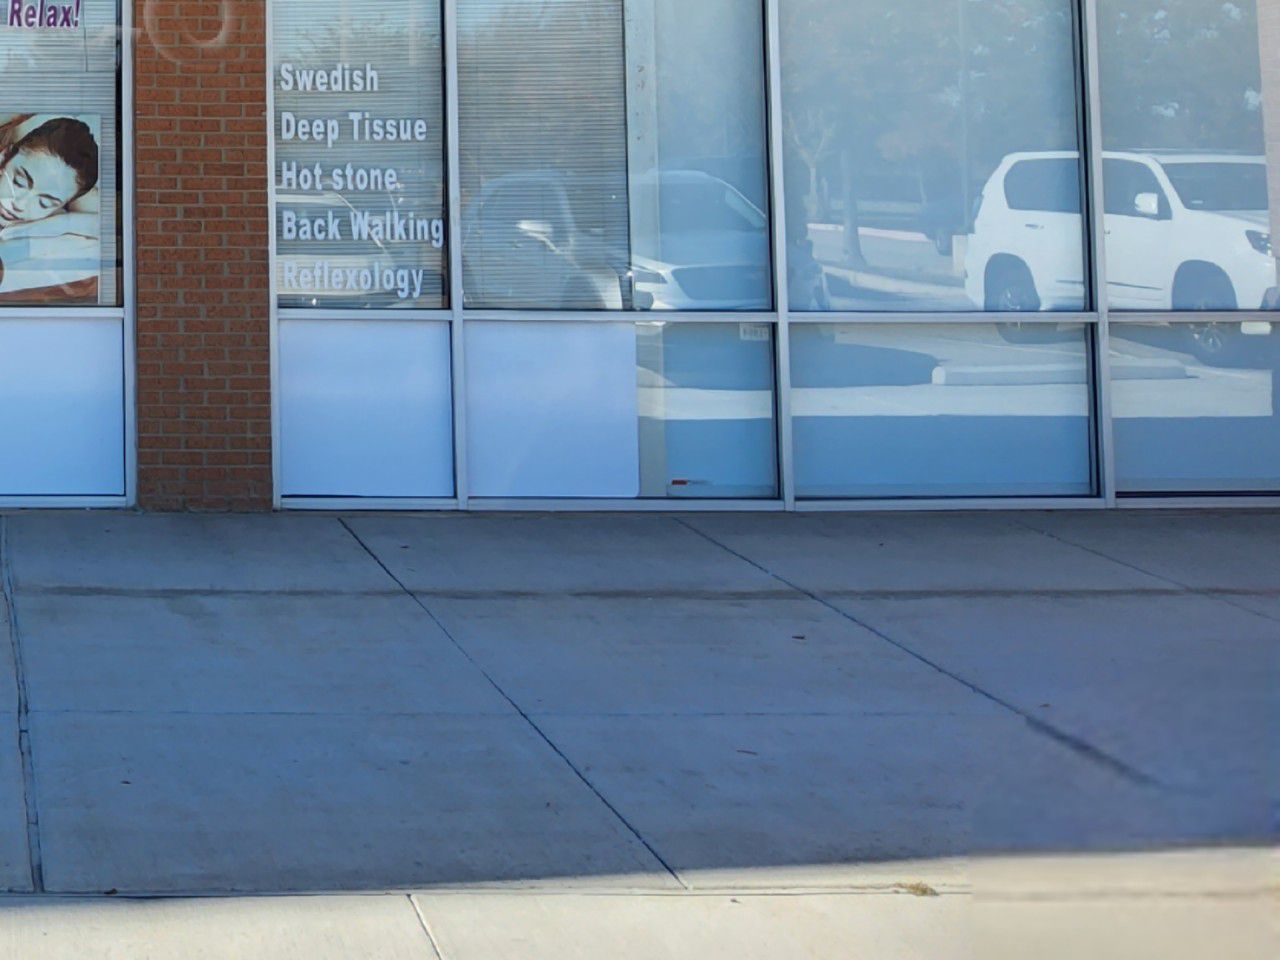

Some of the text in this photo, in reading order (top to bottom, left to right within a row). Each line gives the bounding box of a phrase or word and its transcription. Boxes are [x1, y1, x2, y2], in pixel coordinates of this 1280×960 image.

[279, 62, 380, 92] Swedish
[281, 111, 429, 147] Deep Tissue
[281, 161, 399, 191] Hot stone
[281, 209, 444, 249] Back Walking
[282, 259, 424, 299] Reflexology
